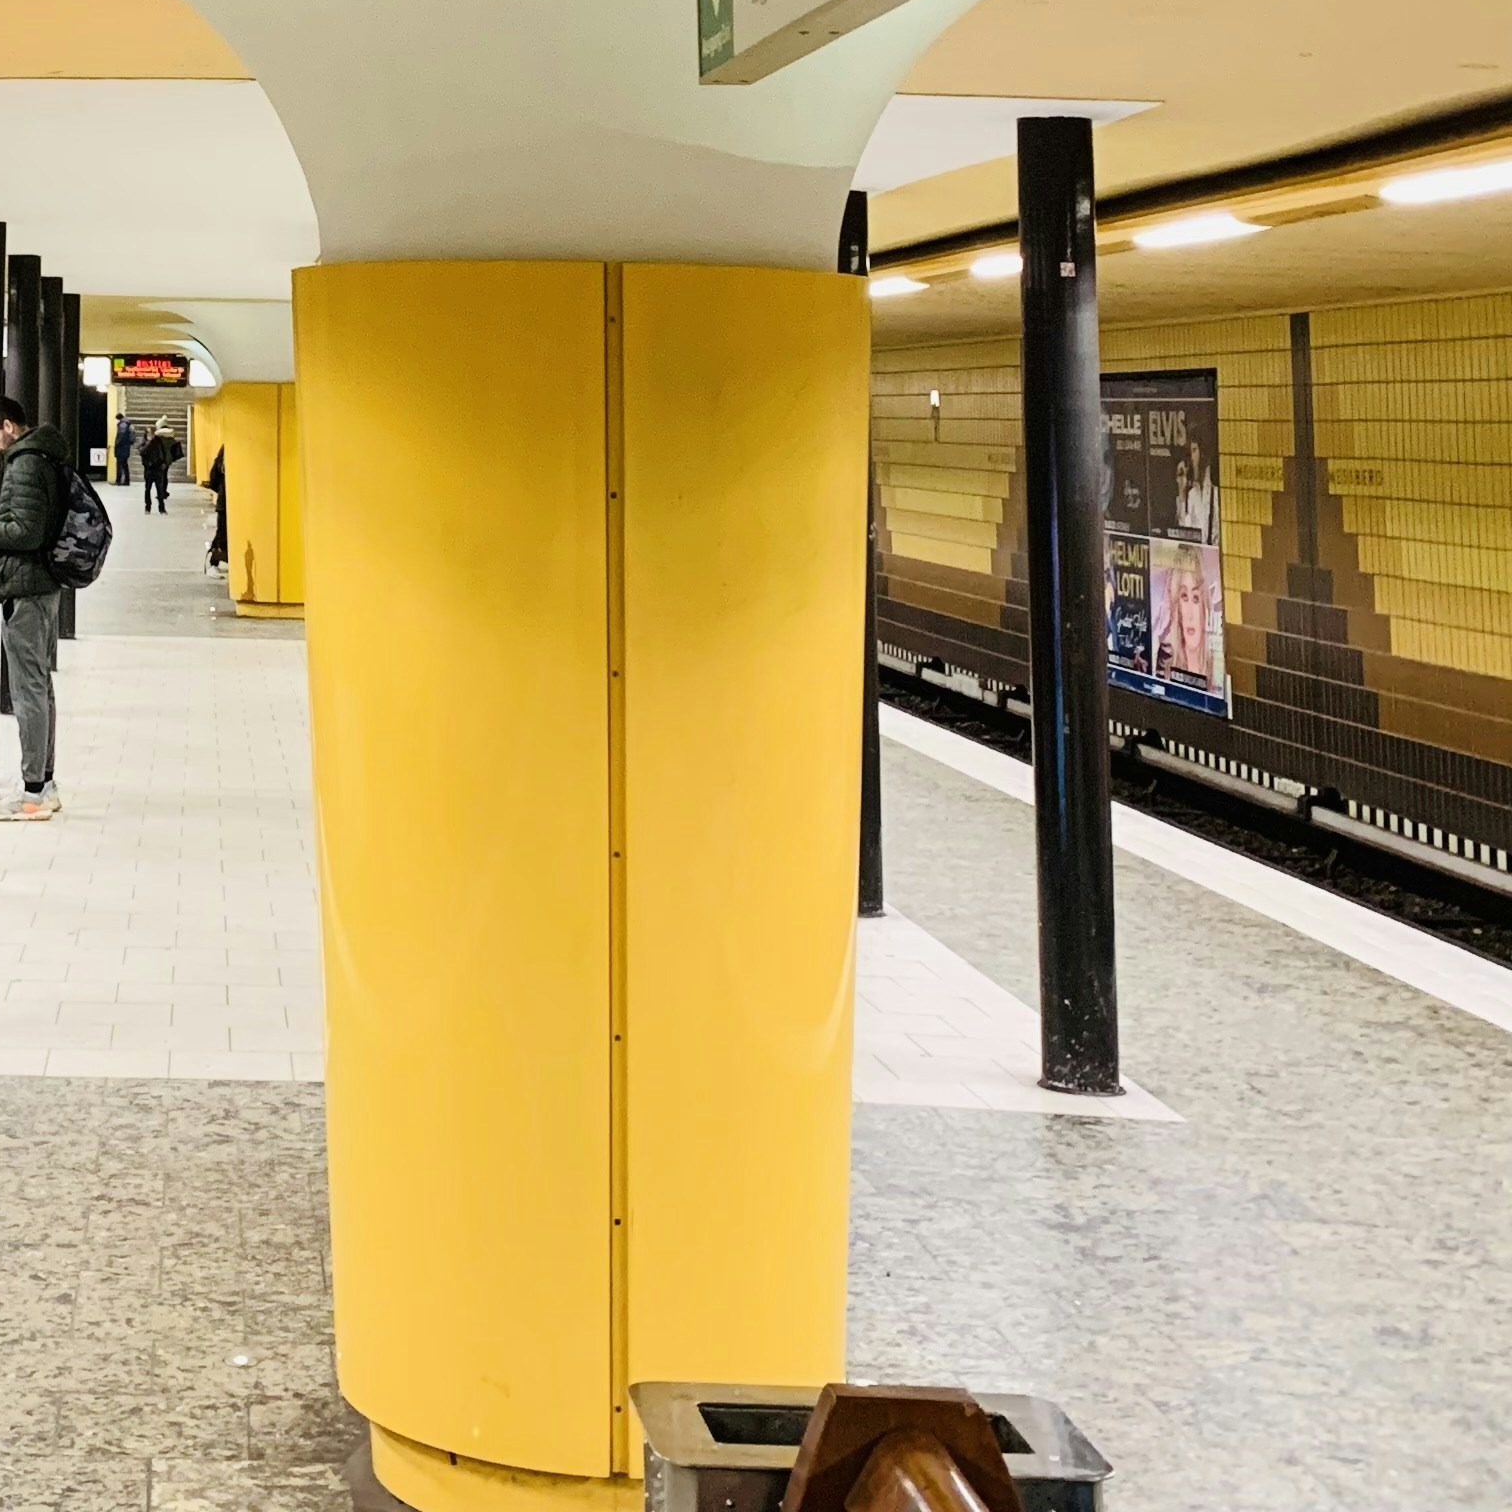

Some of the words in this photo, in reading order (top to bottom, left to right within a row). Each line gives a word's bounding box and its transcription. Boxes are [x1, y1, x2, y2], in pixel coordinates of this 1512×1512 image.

[1149, 410, 1187, 446] ELVIS
[1110, 539, 1150, 569] HELMUT
[1116, 570, 1145, 600] LOTTI
